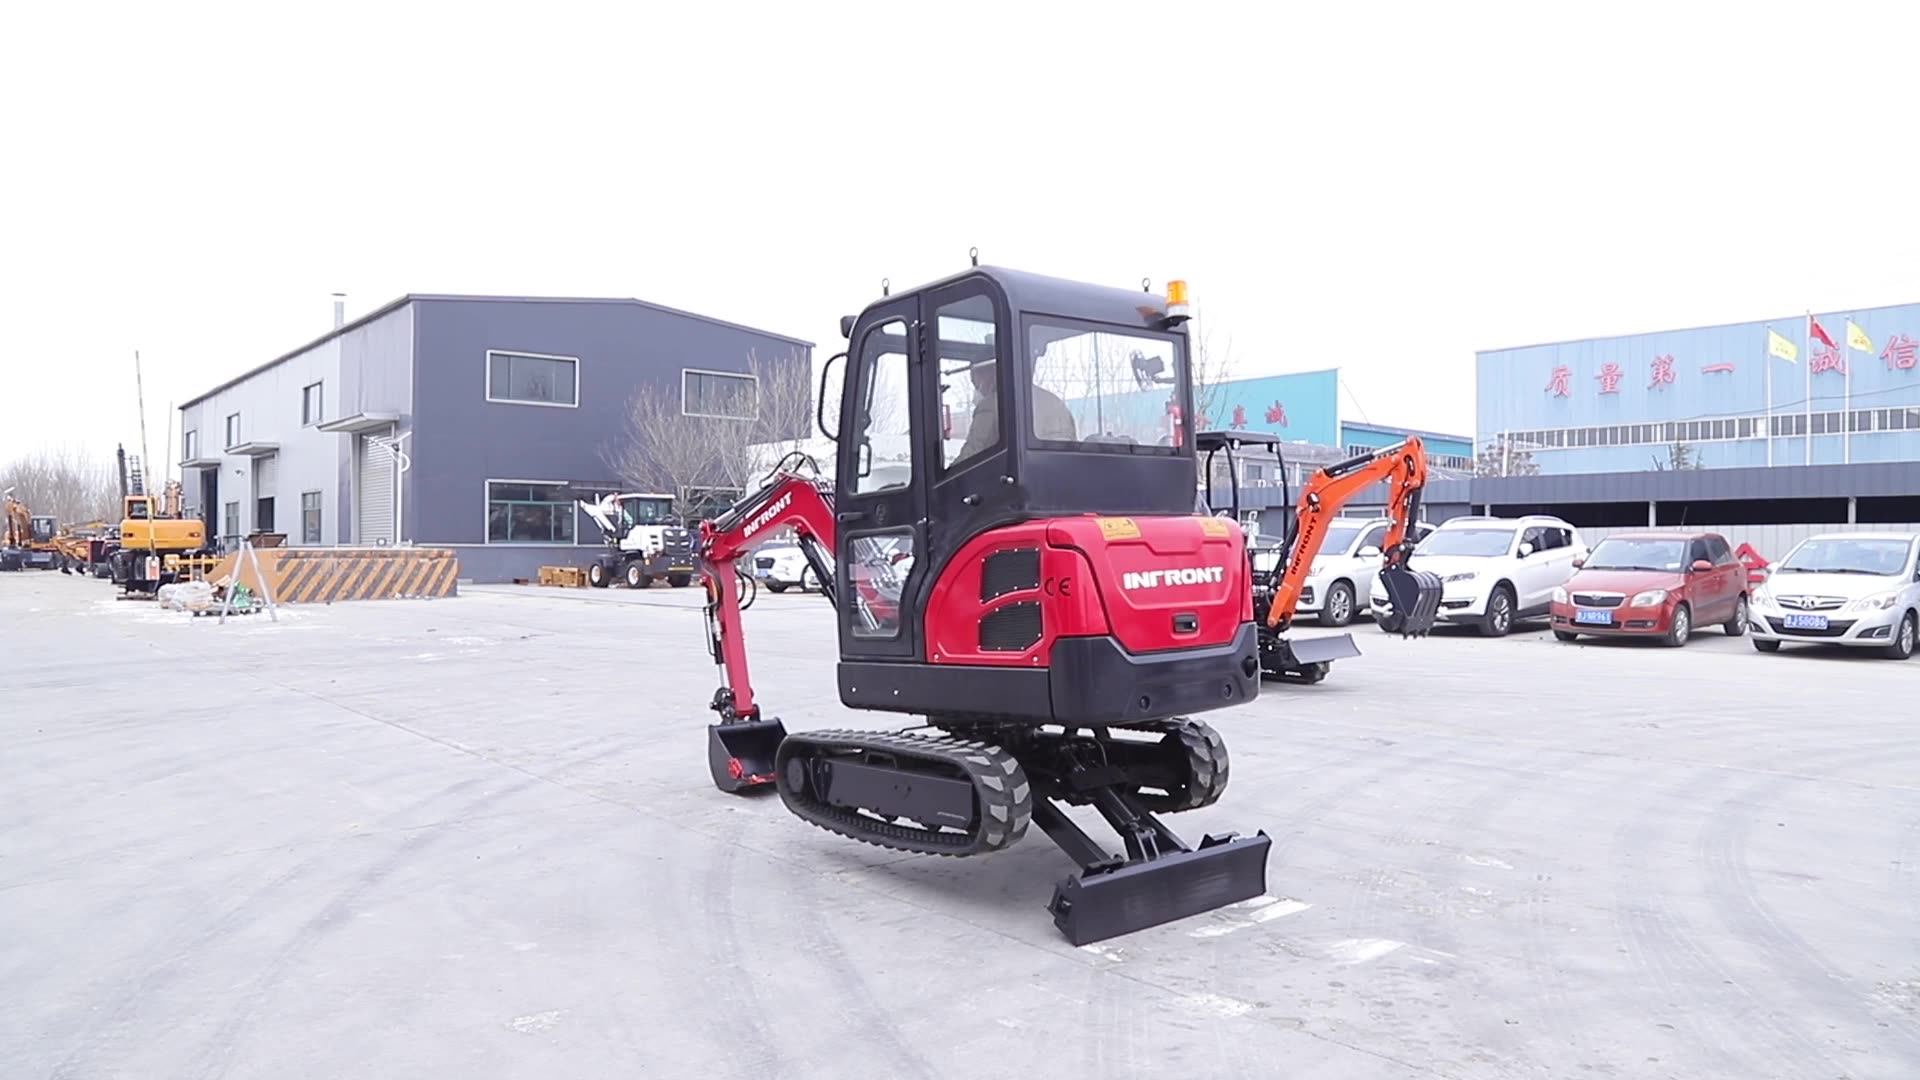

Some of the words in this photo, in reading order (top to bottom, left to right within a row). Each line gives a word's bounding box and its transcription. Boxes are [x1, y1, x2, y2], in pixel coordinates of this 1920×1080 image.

[1545, 352, 1735, 398] 质量第一
[743, 491, 792, 538] INFRONT
[1291, 516, 1317, 575] INFRONT
[1044, 577, 1071, 596] CE
[1123, 566, 1224, 590] INFRONT
